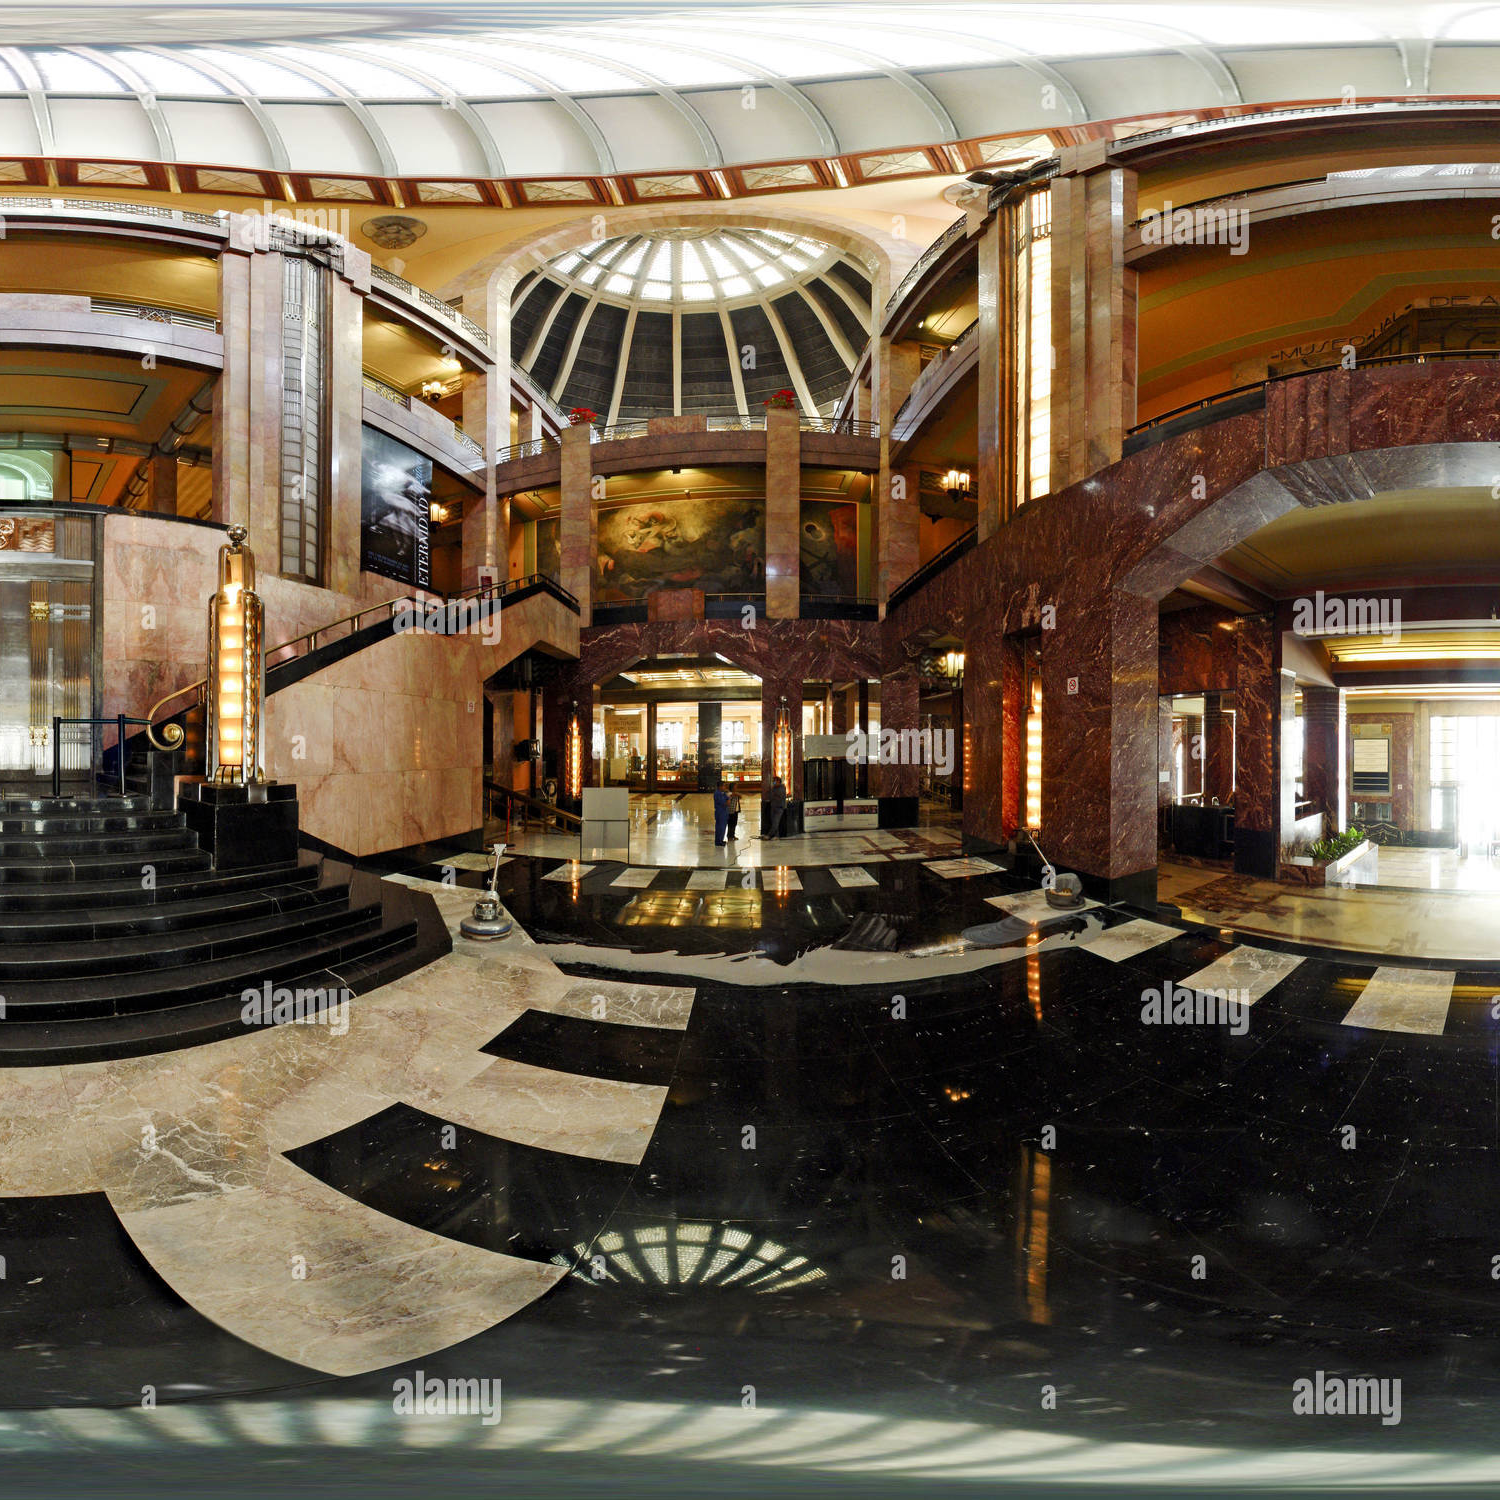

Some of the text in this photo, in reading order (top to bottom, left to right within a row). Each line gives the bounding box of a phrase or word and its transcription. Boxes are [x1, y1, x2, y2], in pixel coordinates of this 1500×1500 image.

[1280, 335, 1365, 360] MUSEO
[1429, 296, 1470, 308] DE
[418, 497, 429, 586] ETERNIDAD
